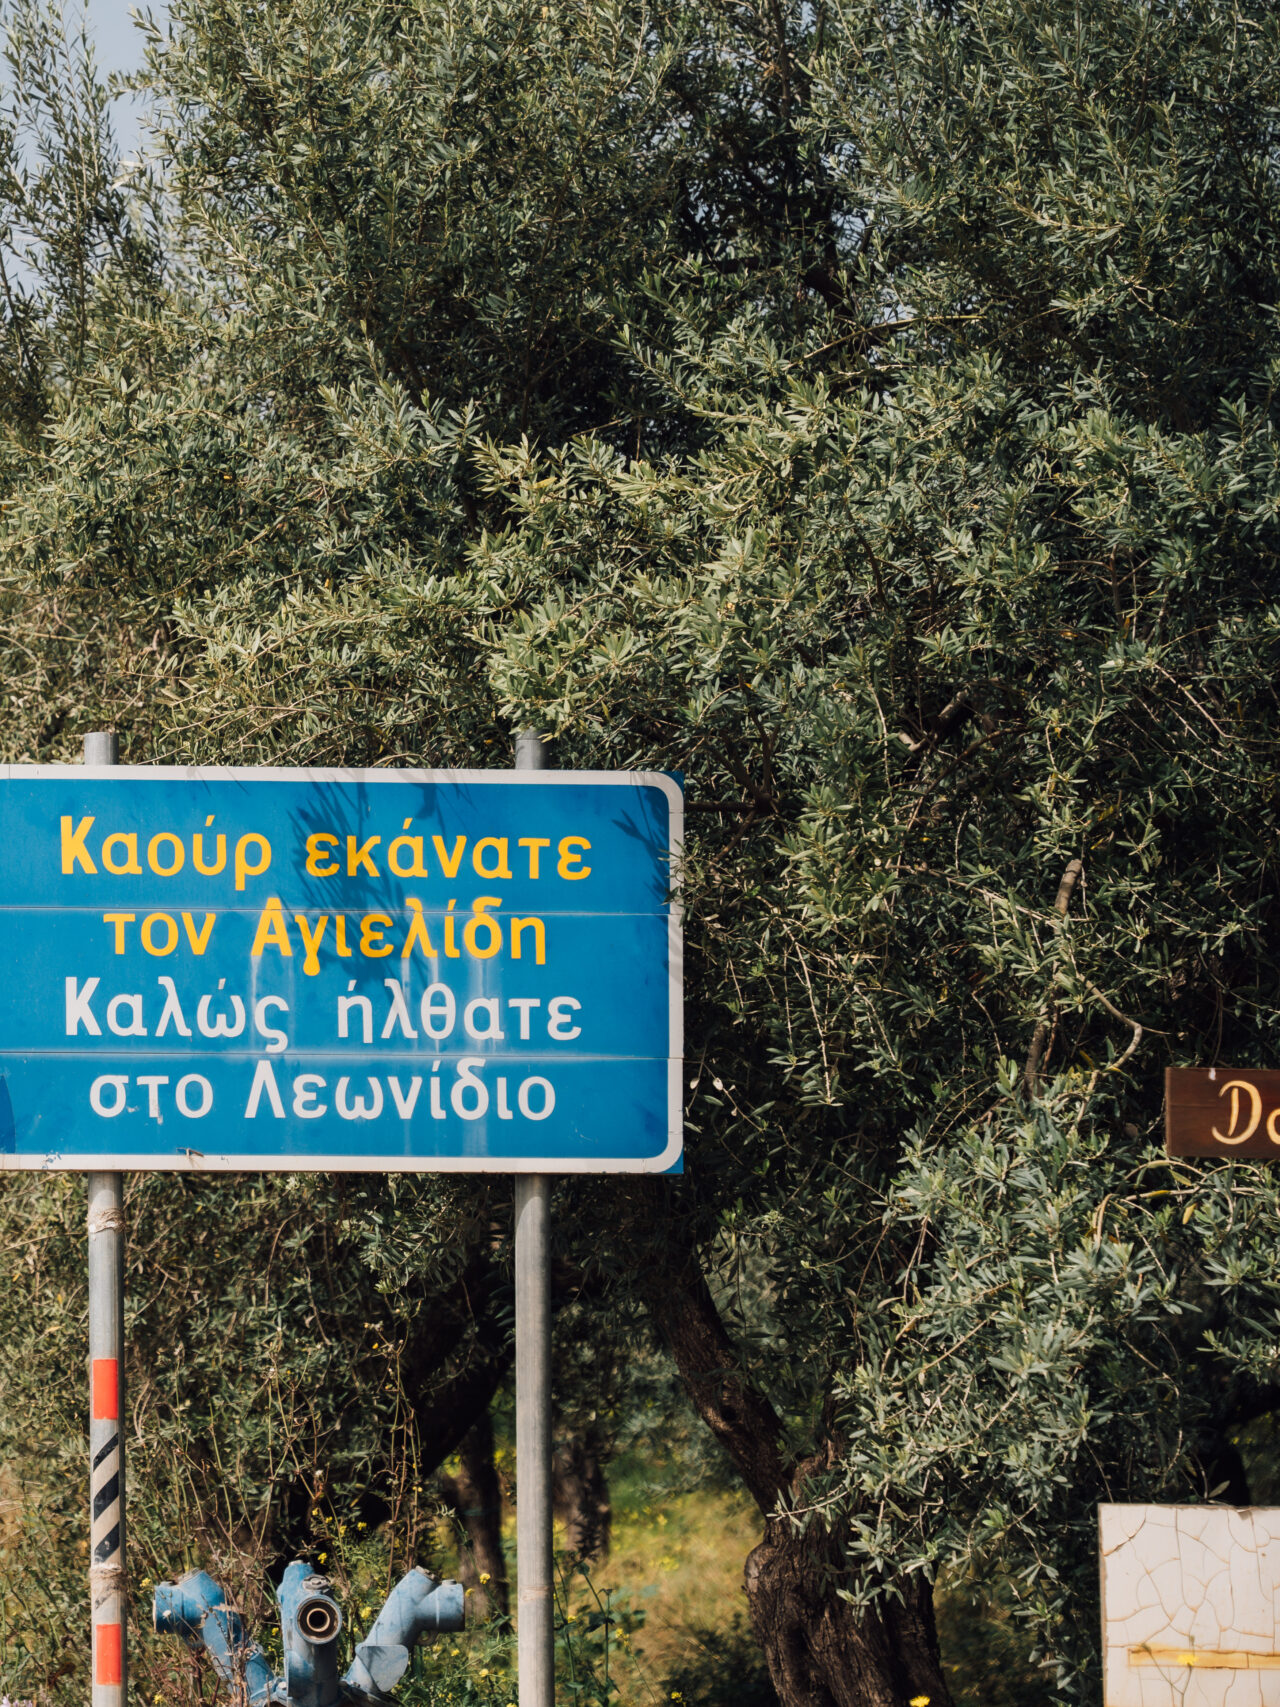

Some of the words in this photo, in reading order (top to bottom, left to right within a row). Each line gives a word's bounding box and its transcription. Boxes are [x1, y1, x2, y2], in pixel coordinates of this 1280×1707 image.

[60, 814, 272, 891] Καούρ
[305, 817, 592, 881] εκάνατε
[102, 912, 217, 957] τον
[251, 896, 547, 977] Αγιελίδη
[65, 976, 290, 1053] Καλώς
[337, 977, 583, 1044] ήλθατε
[89, 1073, 215, 1119] στο
[244, 1058, 557, 1121] Λεωνίδιο
